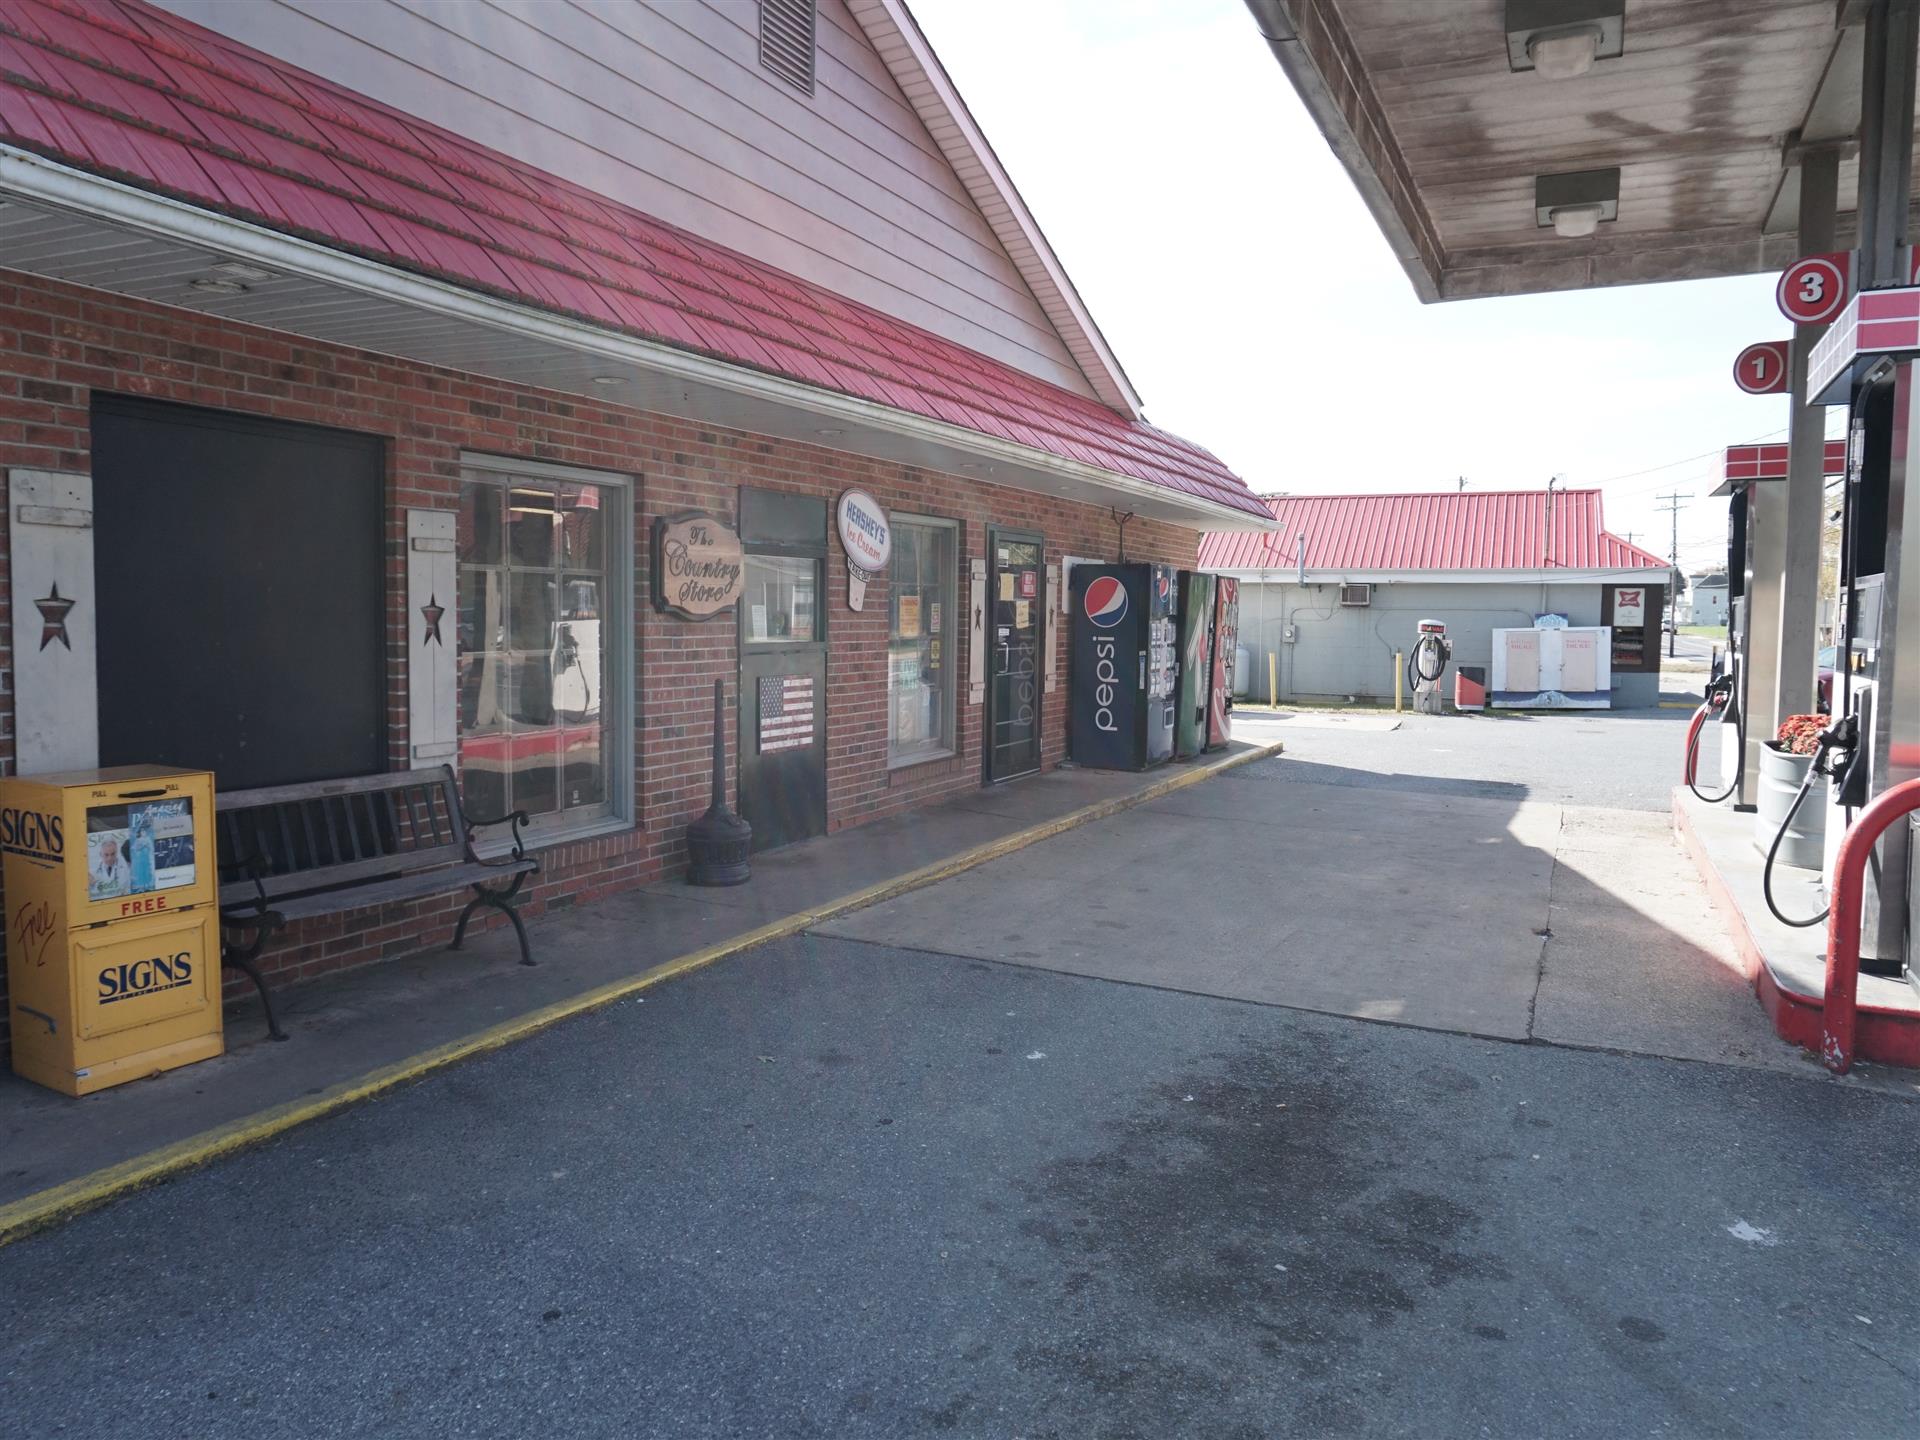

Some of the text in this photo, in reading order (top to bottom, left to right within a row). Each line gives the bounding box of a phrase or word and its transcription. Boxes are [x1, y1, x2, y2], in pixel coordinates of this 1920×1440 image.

[1799, 272, 1824, 302] 3
[1752, 356, 1765, 379] 1
[689, 526, 714, 545] The
[846, 499, 886, 545] HERSHEY'S
[846, 522, 881, 561] Ice Cream
[665, 539, 740, 593] Country
[679, 579, 725, 603] Store
[1093, 636, 1119, 731] pepsi
[92, 790, 107, 798] PULL
[2, 807, 63, 853] SIGNS
[121, 896, 166, 915] FREE
[14, 900, 56, 963] Free
[98, 951, 192, 997] SIGNS
